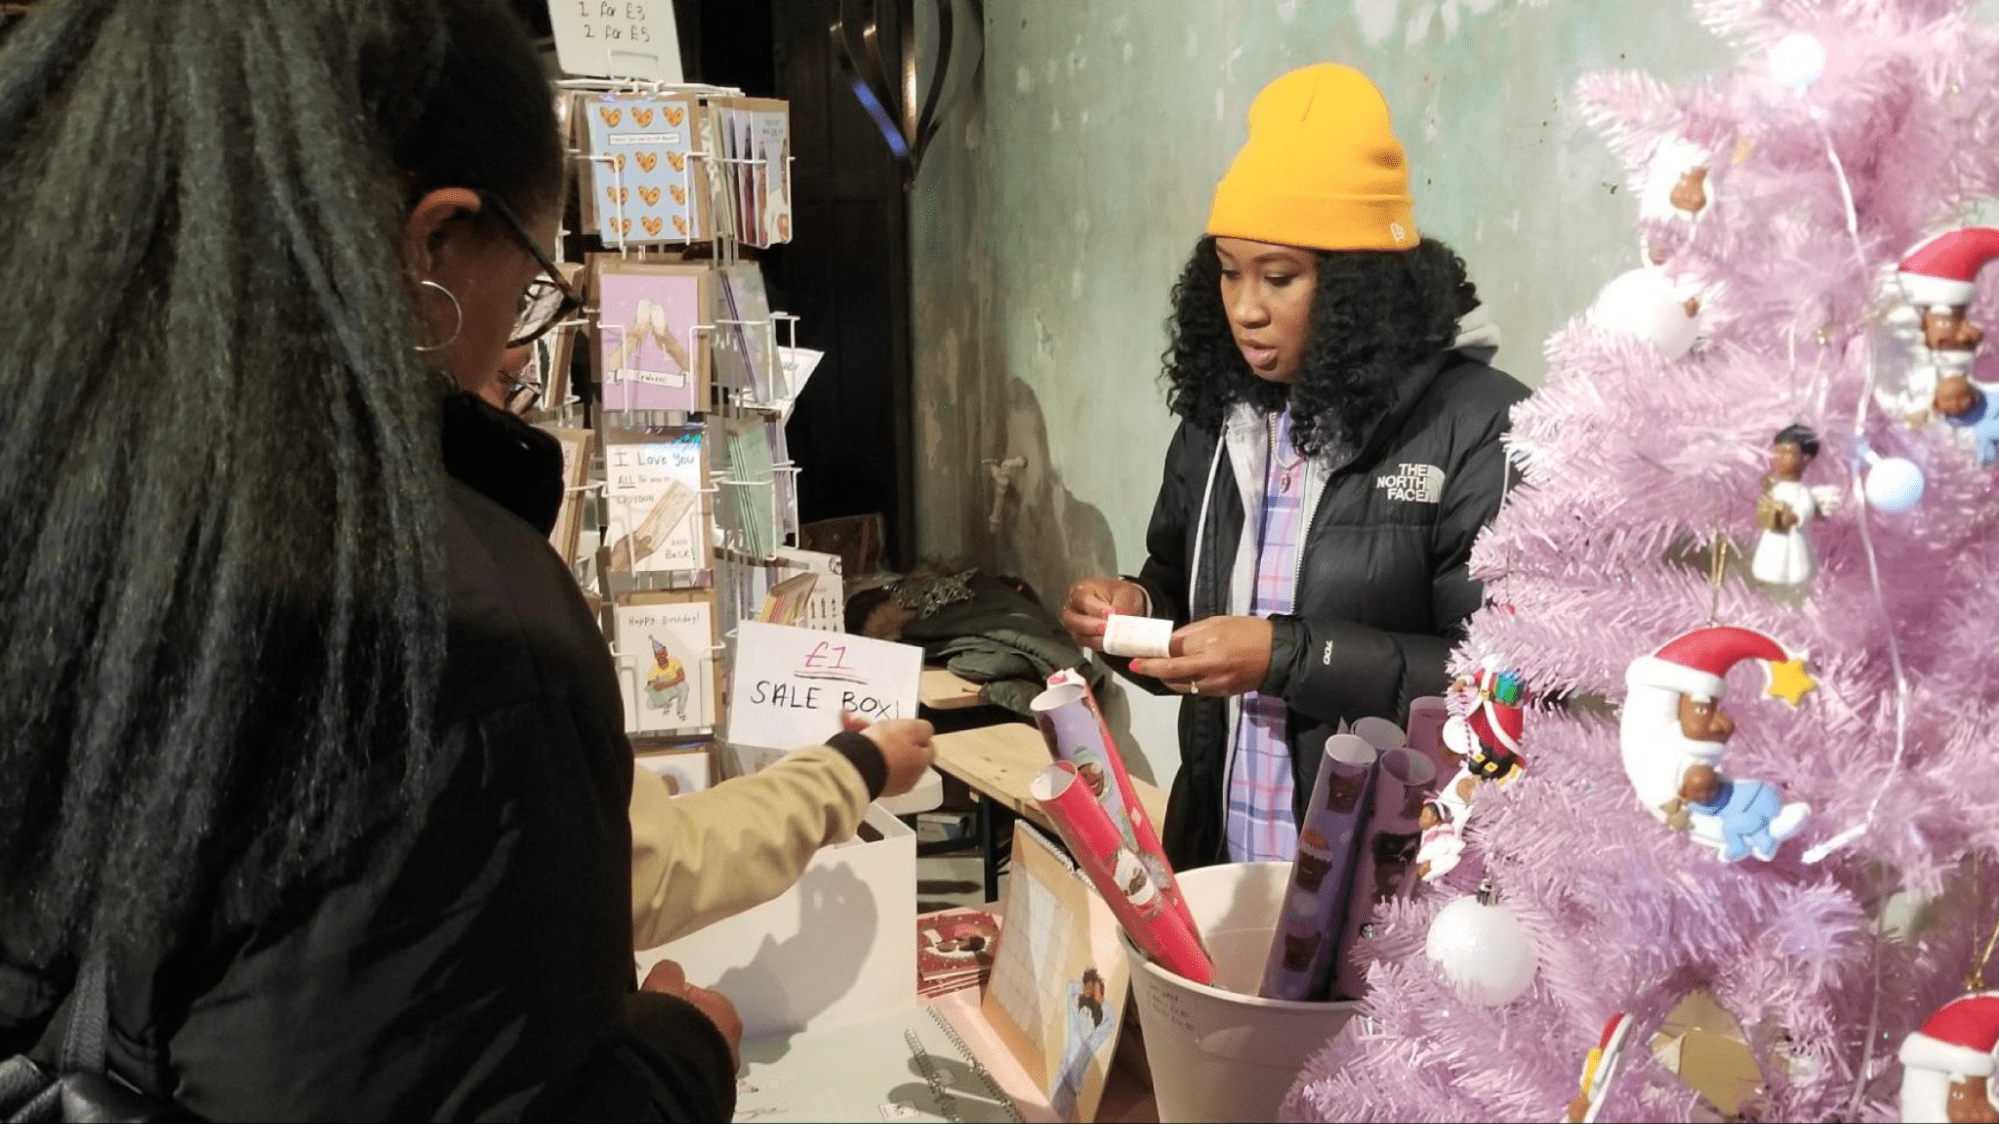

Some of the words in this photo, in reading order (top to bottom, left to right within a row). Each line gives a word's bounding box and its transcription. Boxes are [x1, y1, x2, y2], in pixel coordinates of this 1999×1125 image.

[579, 1, 589, 17] 1
[584, 24, 596, 38] 2
[614, 452, 629, 467] I
[1399, 463, 1428, 477] THE
[1376, 475, 1426, 491] NORTH
[1387, 488, 1427, 502] FACE
[805, 641, 856, 670] £1
[750, 680, 822, 709] SALE
